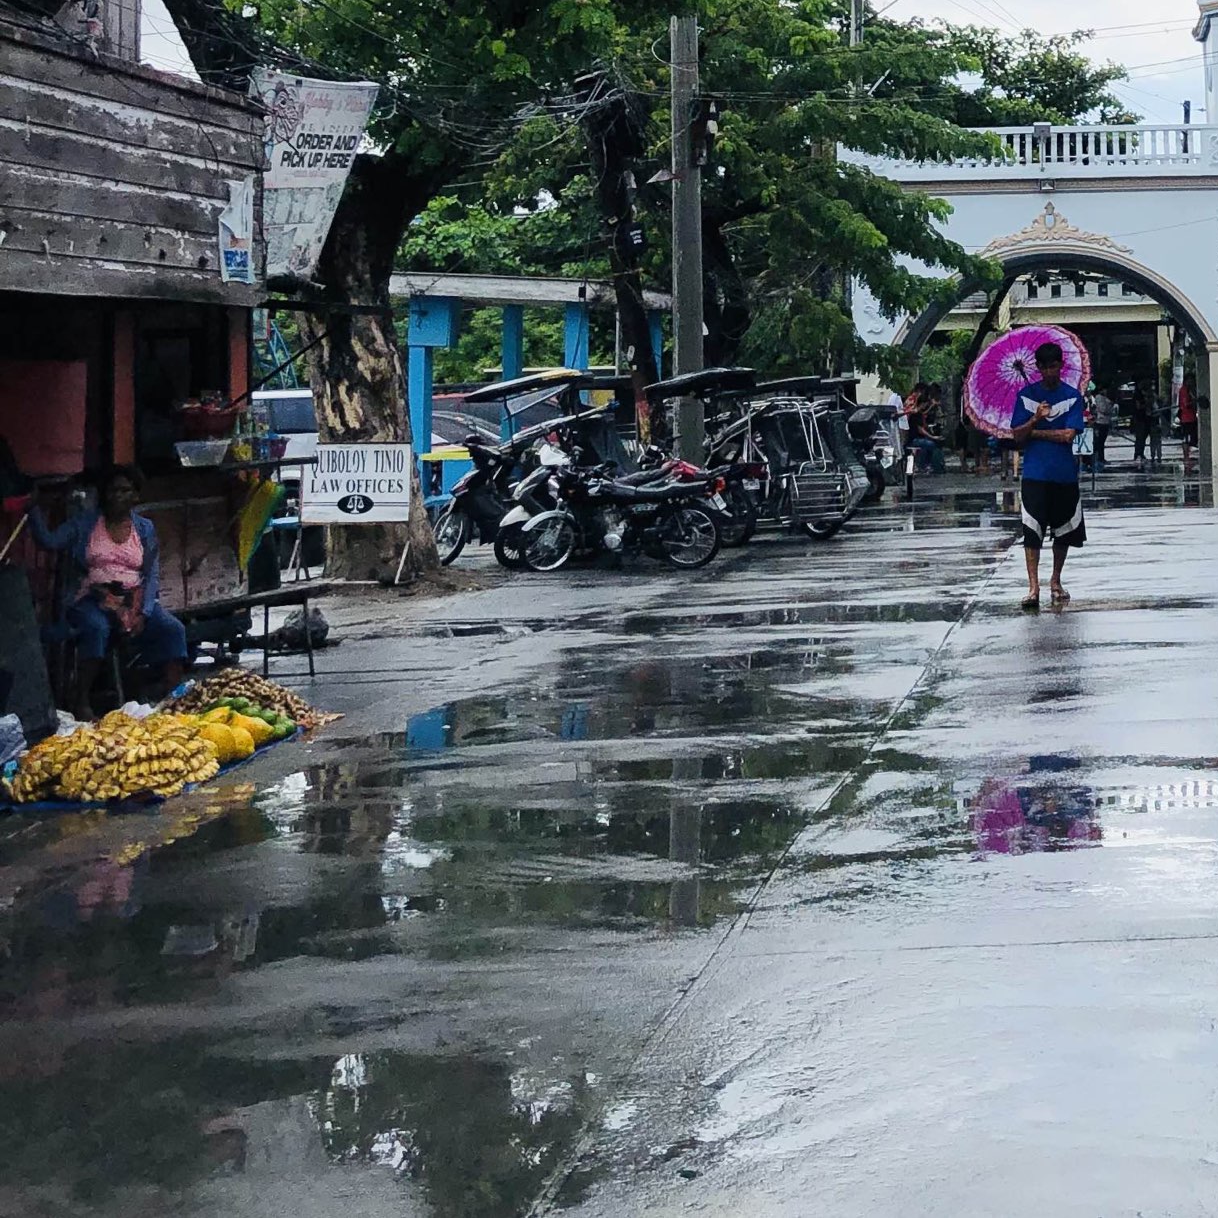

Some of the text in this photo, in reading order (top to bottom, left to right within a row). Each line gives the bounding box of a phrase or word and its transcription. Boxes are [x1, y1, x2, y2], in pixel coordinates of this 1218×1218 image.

[296, 132, 358, 151] ORDER AND
[280, 150, 352, 169] PICK UP HERE
[310, 449, 405, 479] QUIBOLOY TINIO
[310, 478, 404, 494] LAW OFFICES
